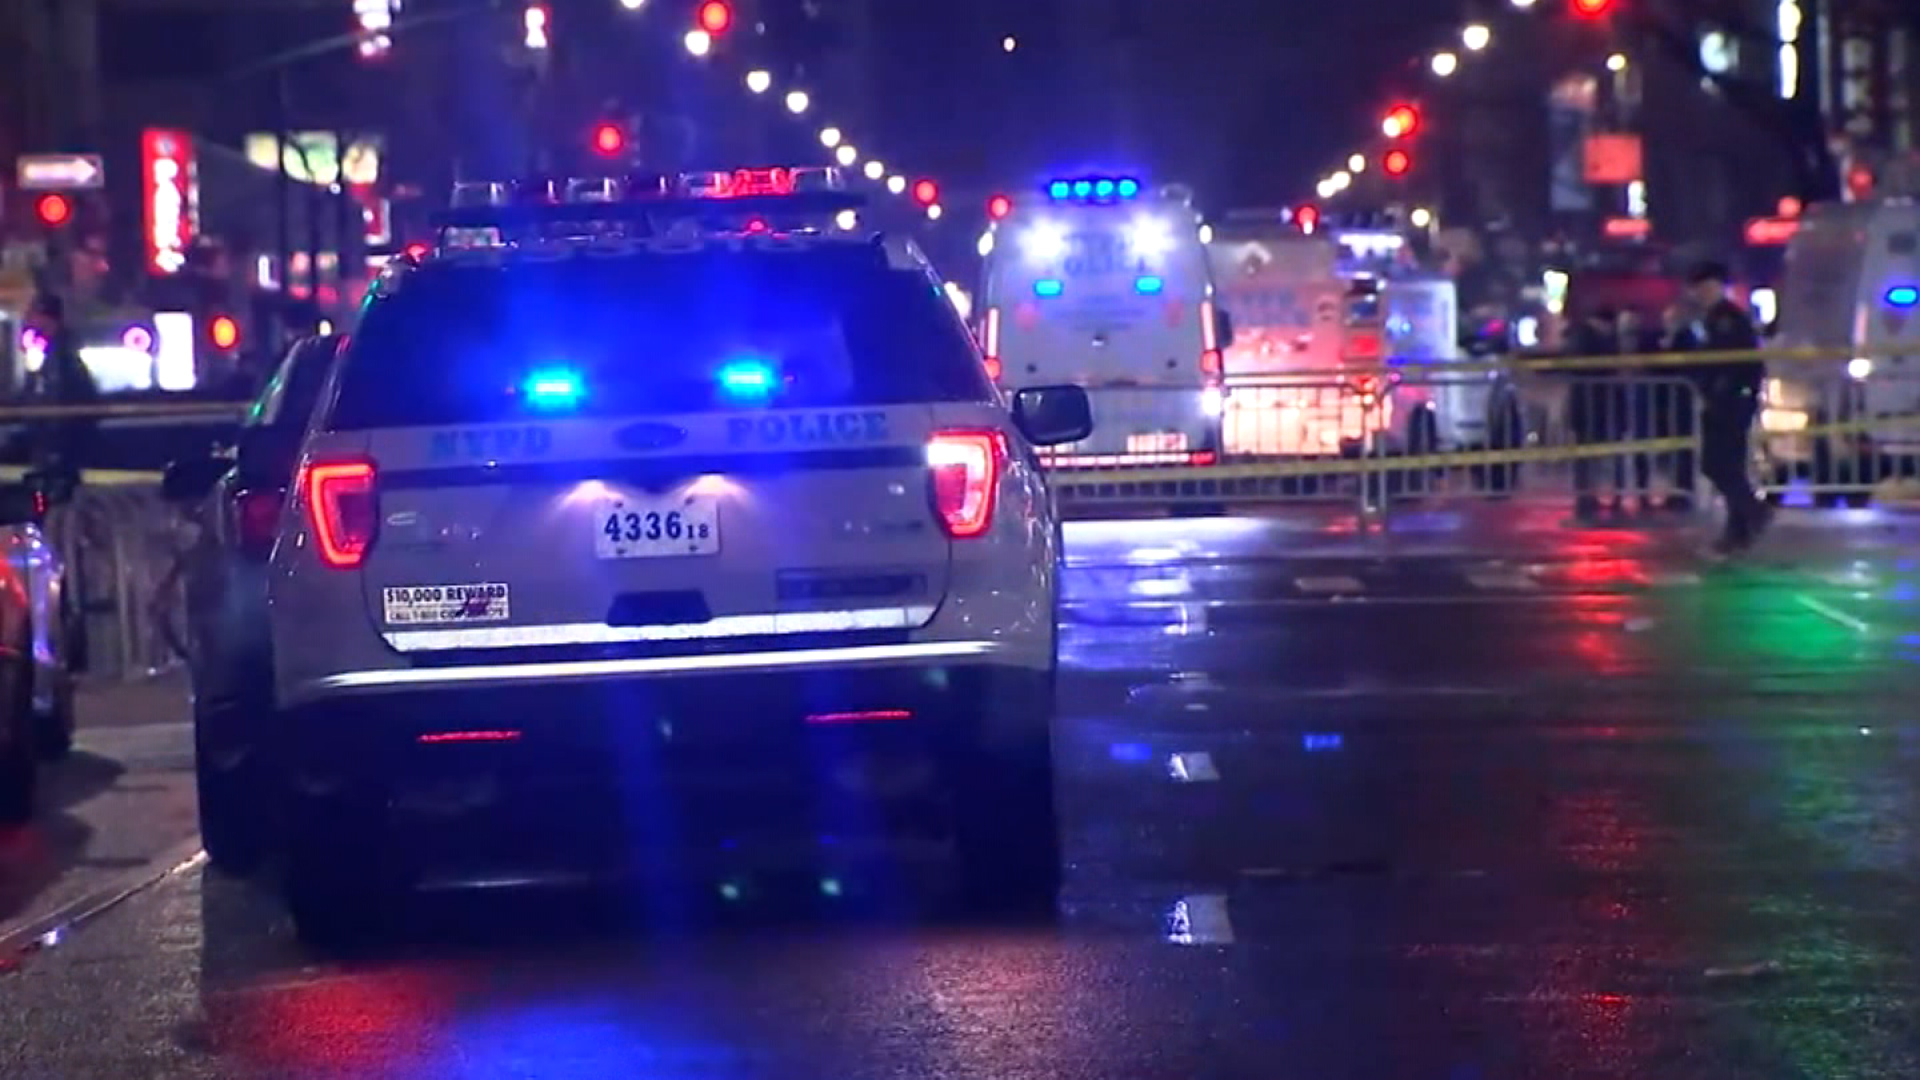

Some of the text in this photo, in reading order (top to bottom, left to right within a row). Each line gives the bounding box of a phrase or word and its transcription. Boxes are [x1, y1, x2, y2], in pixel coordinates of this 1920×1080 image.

[430, 411, 889, 459] NYPD POLICE
[604, 510, 709, 542] 4336 18
[387, 585, 505, 607] $10,000 REWARD
